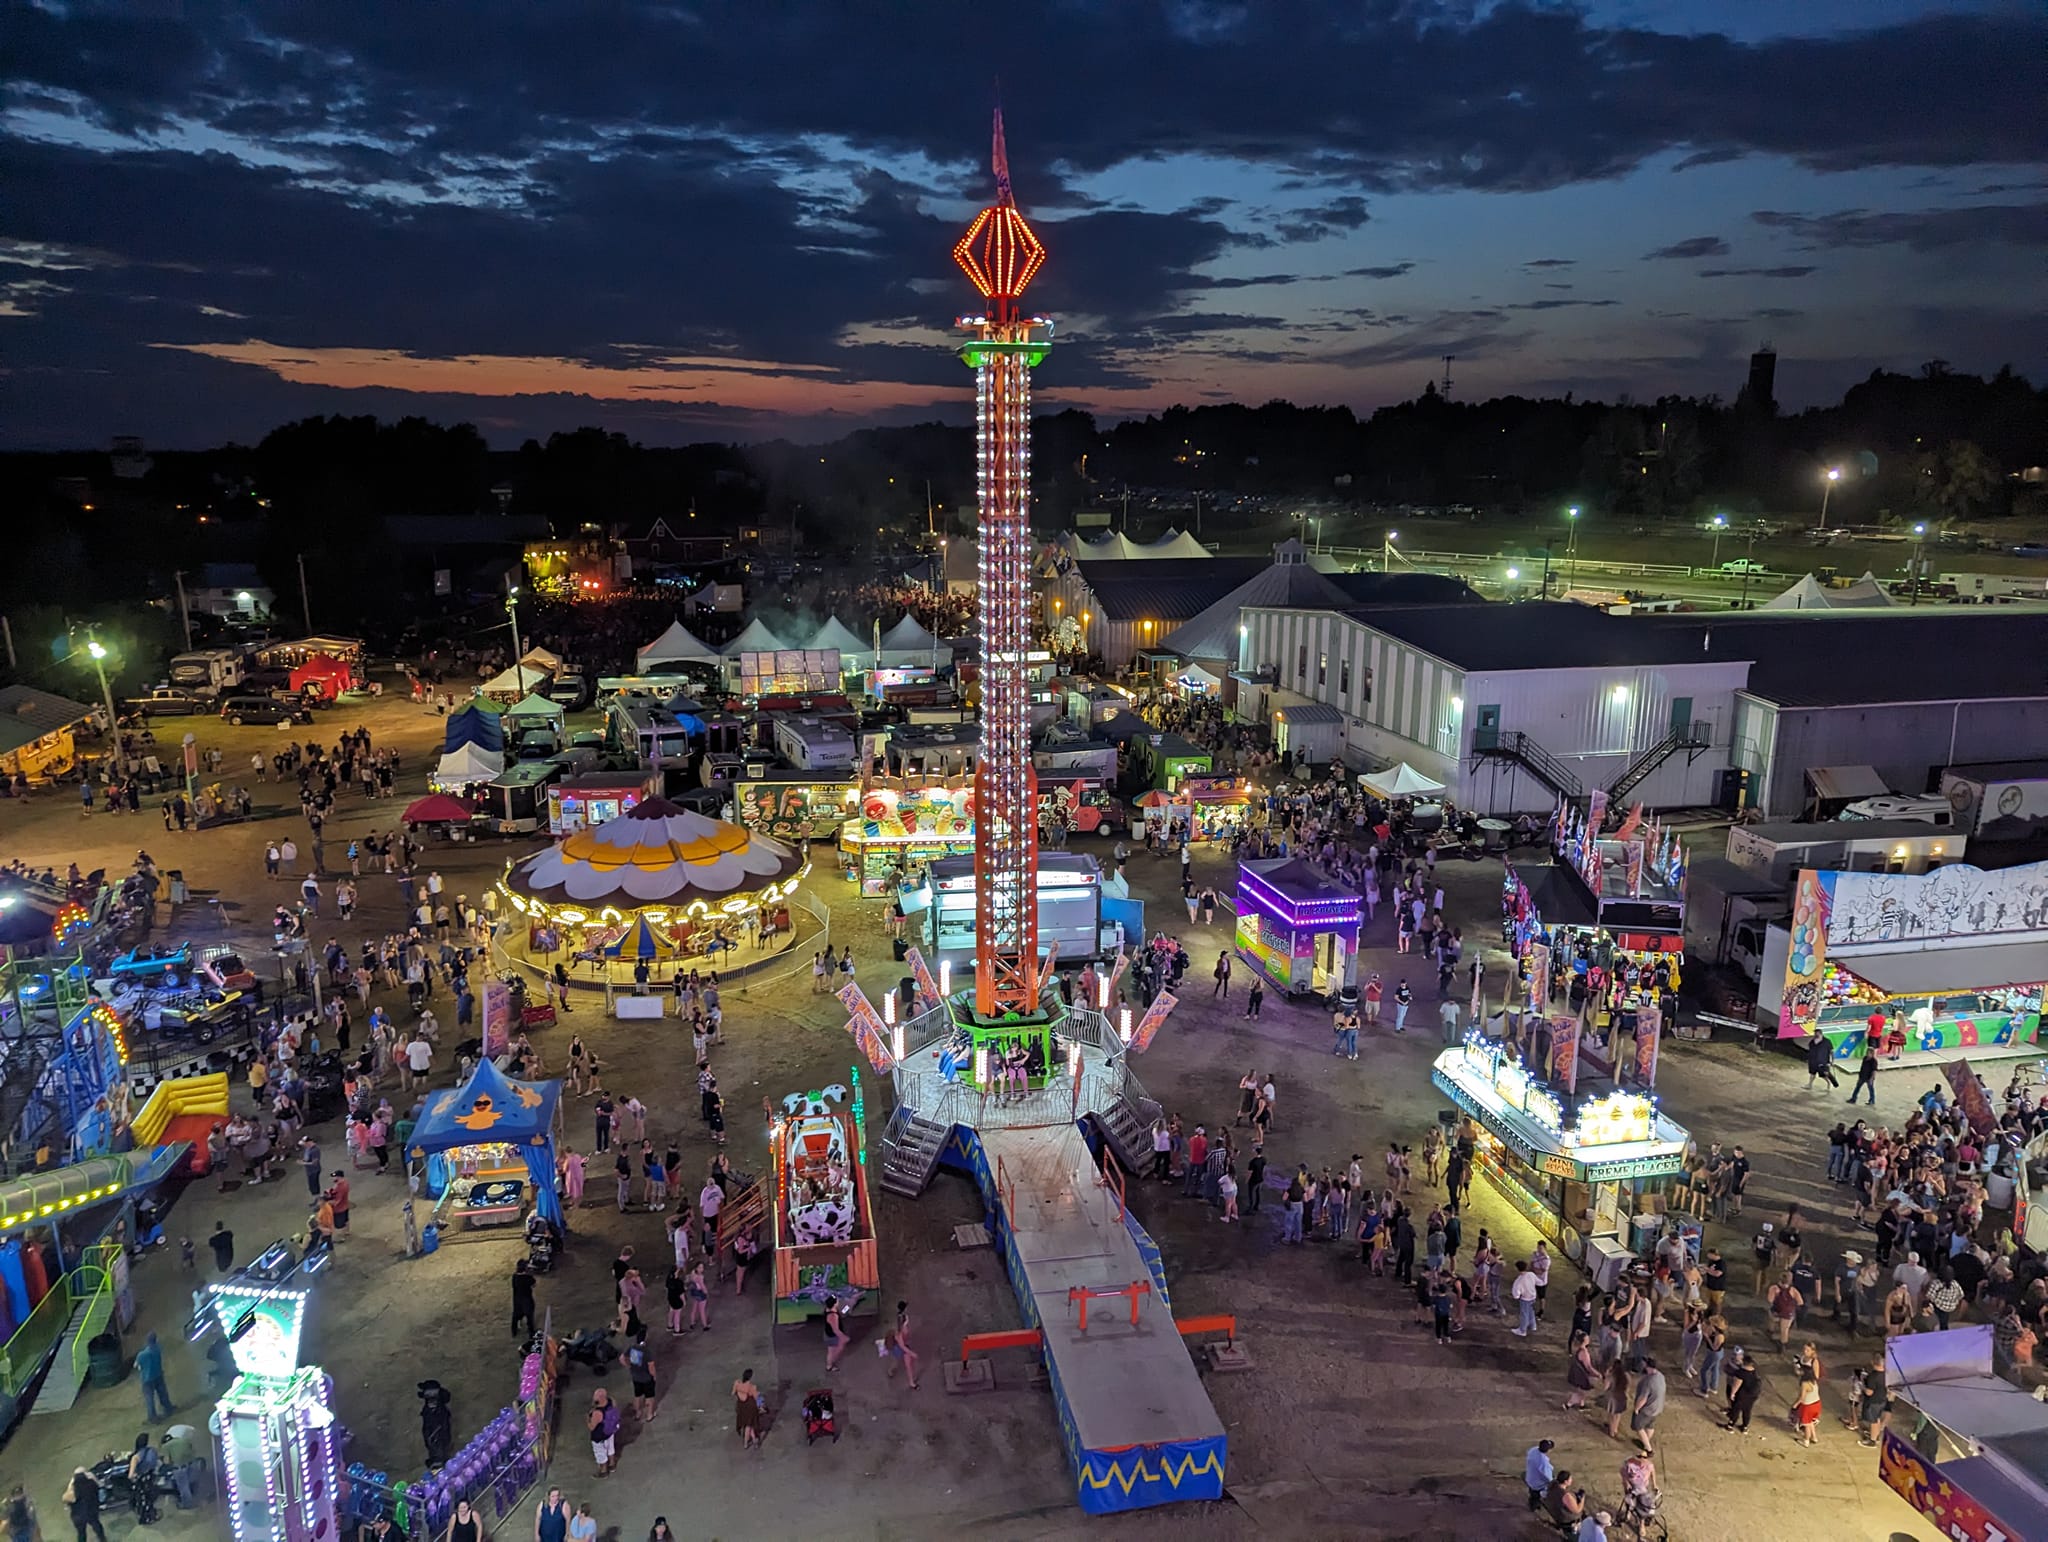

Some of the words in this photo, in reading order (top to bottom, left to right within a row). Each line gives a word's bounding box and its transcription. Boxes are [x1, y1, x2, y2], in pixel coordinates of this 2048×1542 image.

[1548, 1156, 1575, 1168] MINI
[1589, 1164, 1631, 1179] CRÈME
[1633, 1159, 1679, 1176] GLACÉE
